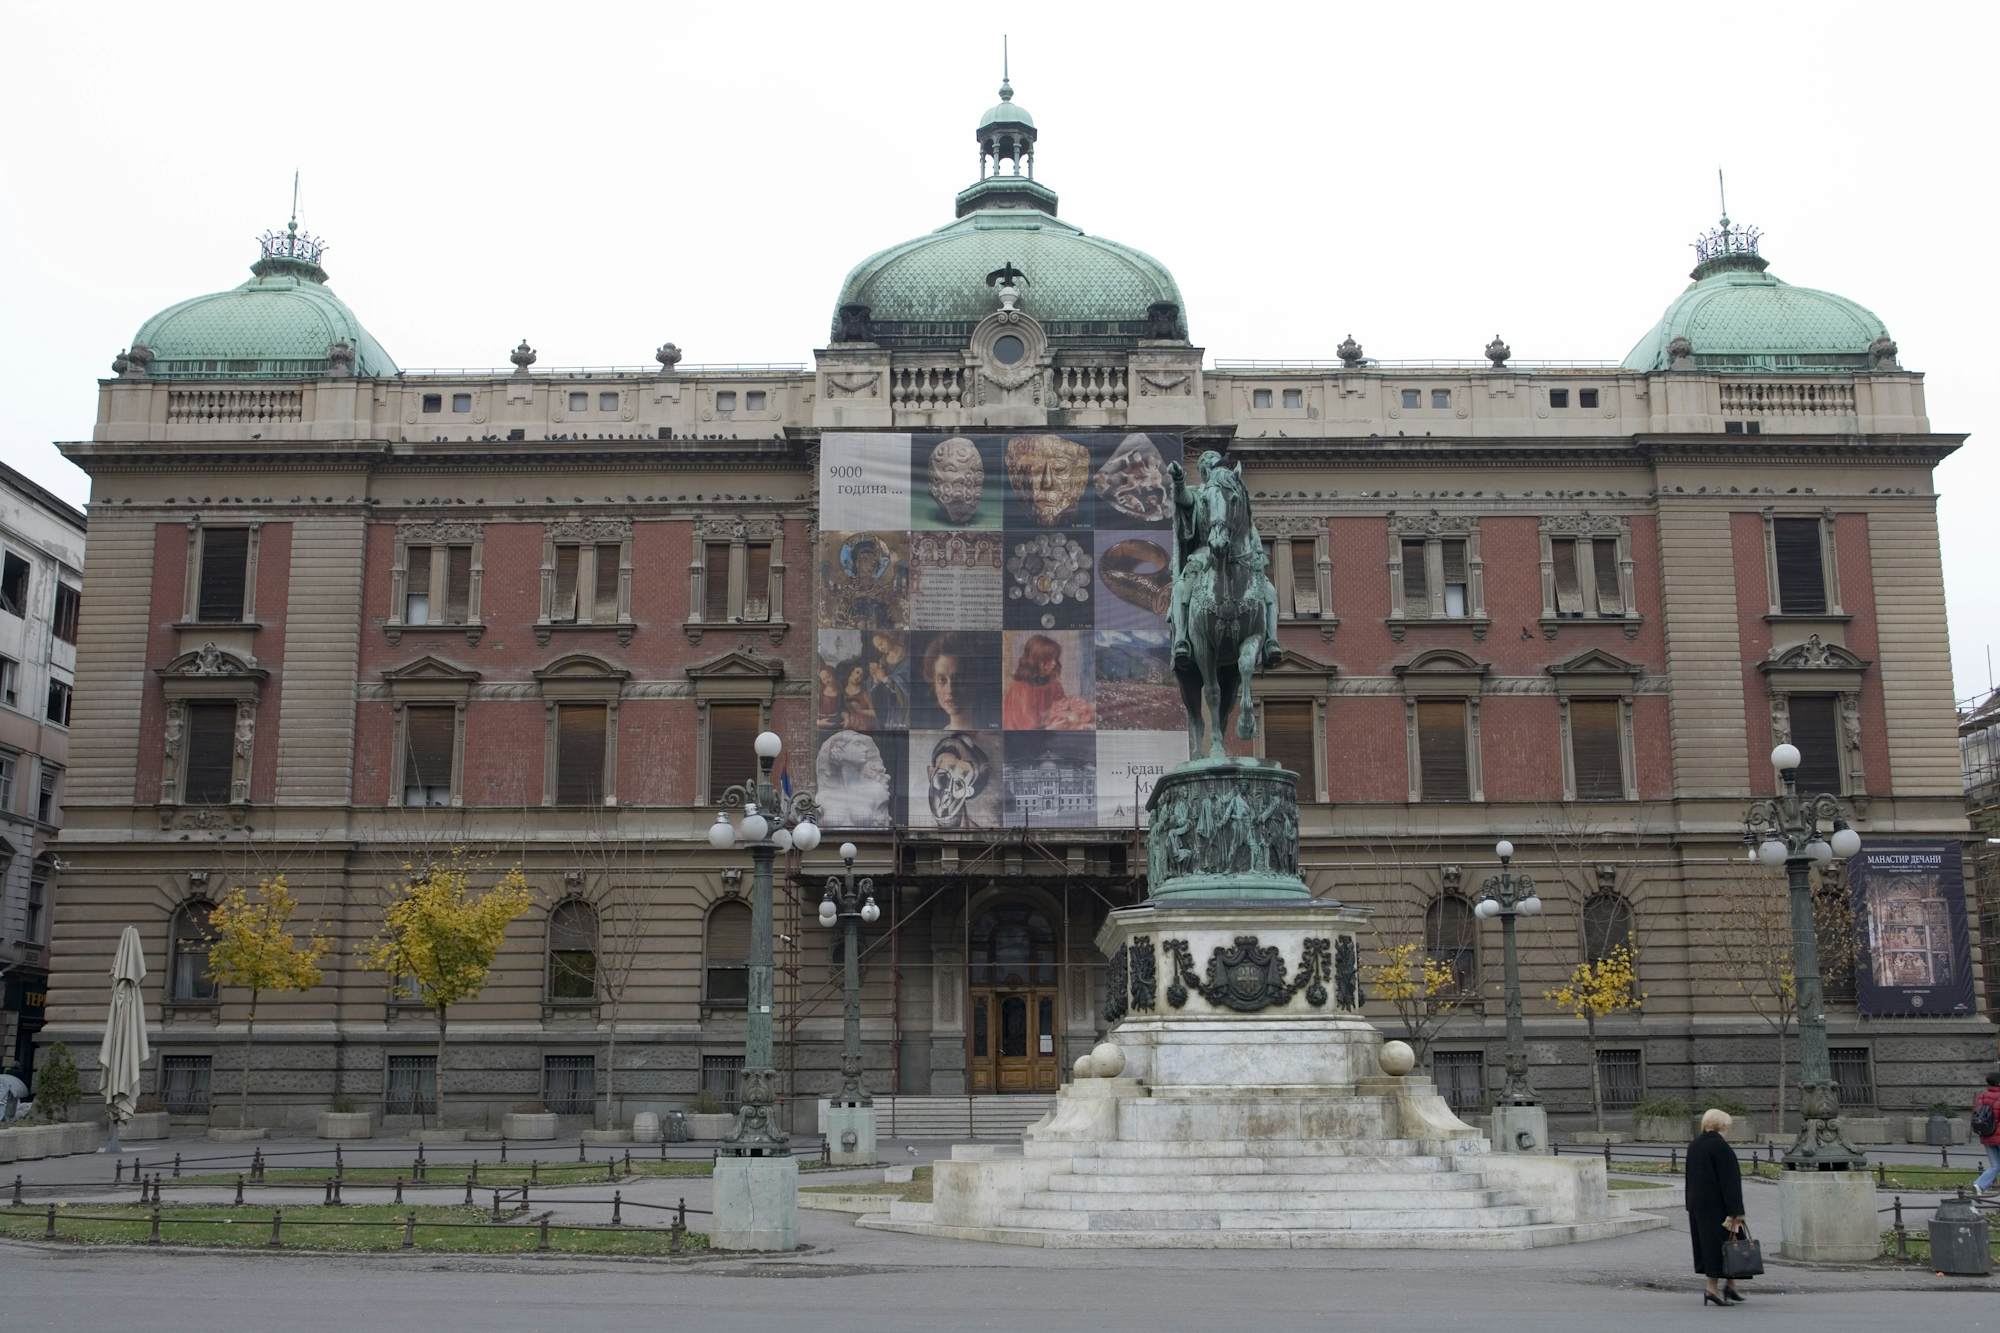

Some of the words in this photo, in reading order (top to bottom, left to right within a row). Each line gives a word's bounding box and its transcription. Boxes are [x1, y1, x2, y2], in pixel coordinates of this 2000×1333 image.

[830, 465, 862, 478] 9000
[838, 484, 887, 496] година
[1126, 761, 1164, 779] један
[1867, 855, 1909, 864] МАНАСТИР
[1910, 855, 1942, 864] ДЕЧАНИ
